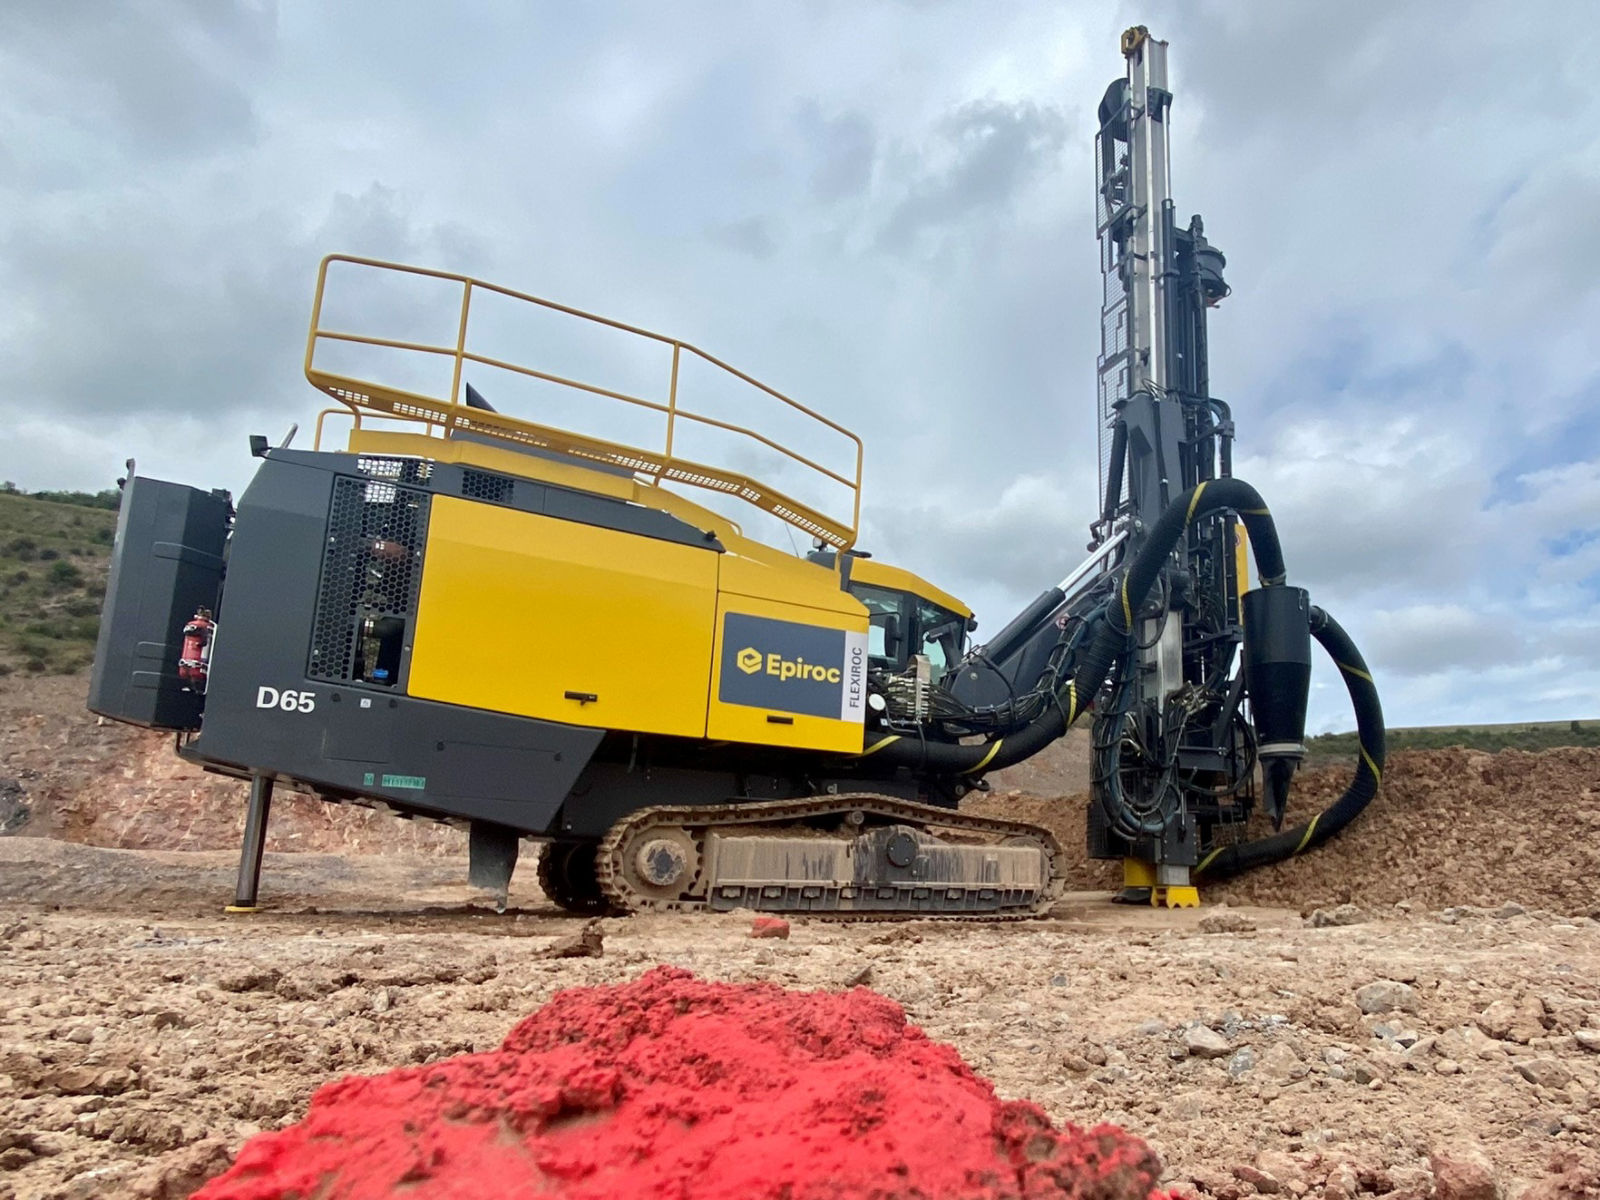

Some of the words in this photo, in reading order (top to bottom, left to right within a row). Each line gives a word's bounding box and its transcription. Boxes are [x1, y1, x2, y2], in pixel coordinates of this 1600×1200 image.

[766, 653, 841, 684] Epiroc
[849, 647, 863, 708] FLEXIROC
[256, 686, 316, 713] D65
